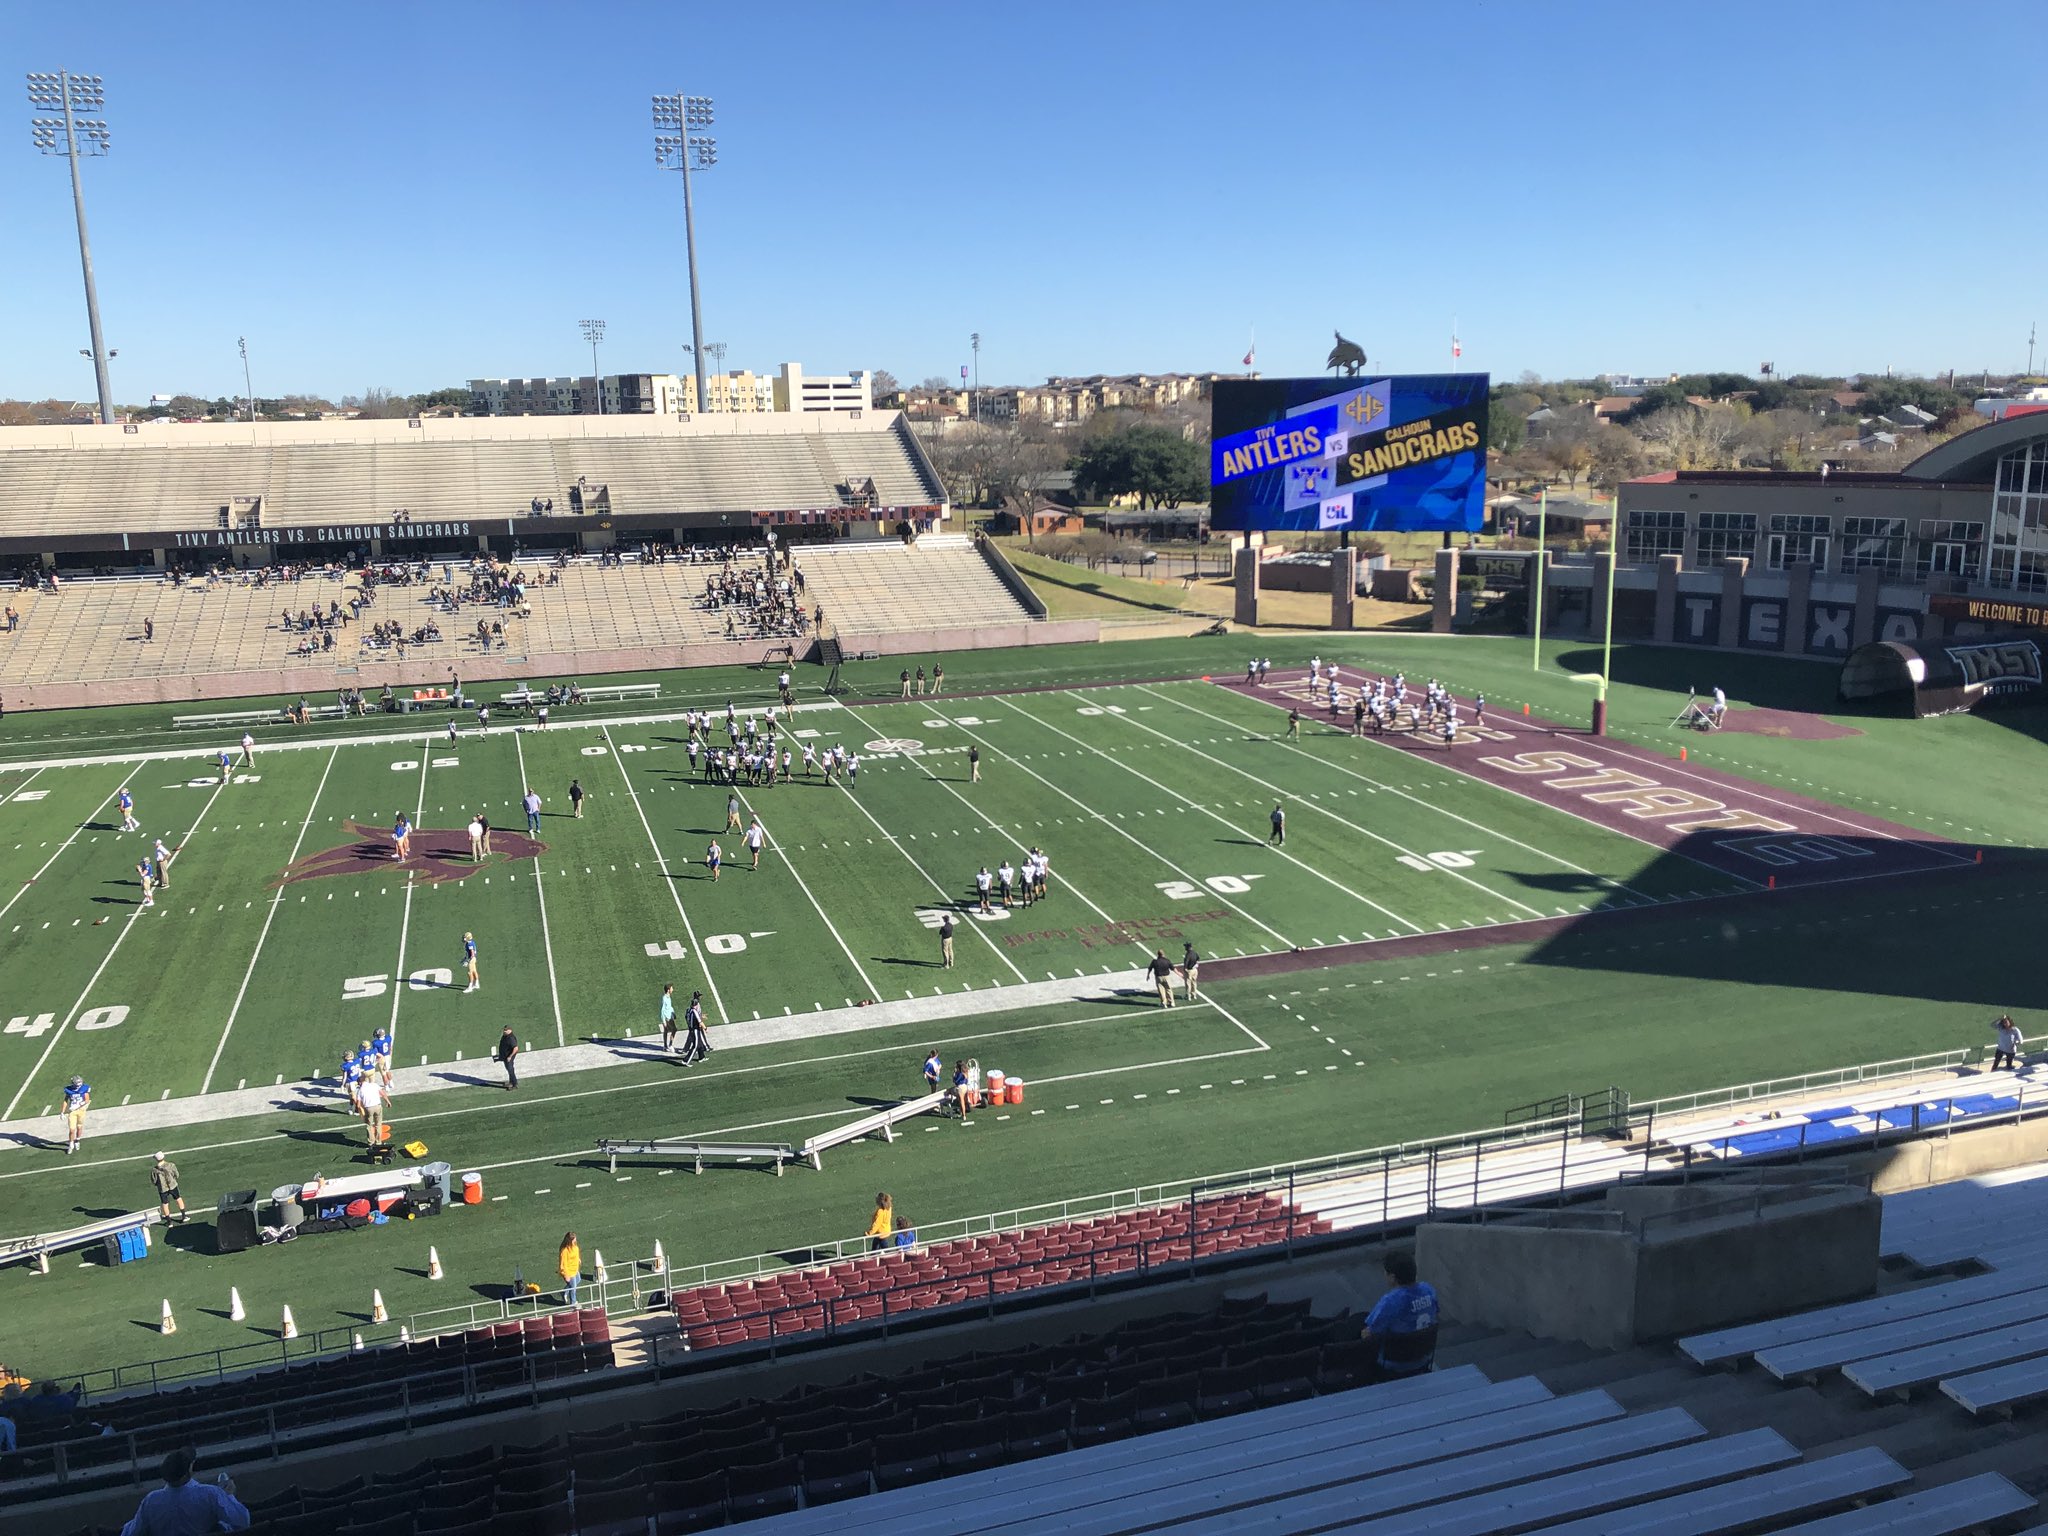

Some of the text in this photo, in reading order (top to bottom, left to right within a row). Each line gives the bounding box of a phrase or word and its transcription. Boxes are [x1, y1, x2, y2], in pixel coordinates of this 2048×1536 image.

[1255, 426, 1277, 440] TIVY
[1385, 419, 1432, 441] CALHOUN
[1222, 426, 1321, 478] ANTLERS
[1349, 421, 1479, 478] SANDCRABS
[176, 523, 470, 547] TIVY ANTLERS VS. CALHOUN SANDCRABS
[1969, 602, 2023, 622] WELCOME
[2026, 608, 2040, 624] TO
[1950, 643, 2038, 683] TXST
[1395, 851, 1476, 871] 10
[1154, 875, 1251, 900] 20
[644, 933, 747, 960] 40
[342, 968, 453, 1000] 50
[3, 1005, 131, 1038] 40
